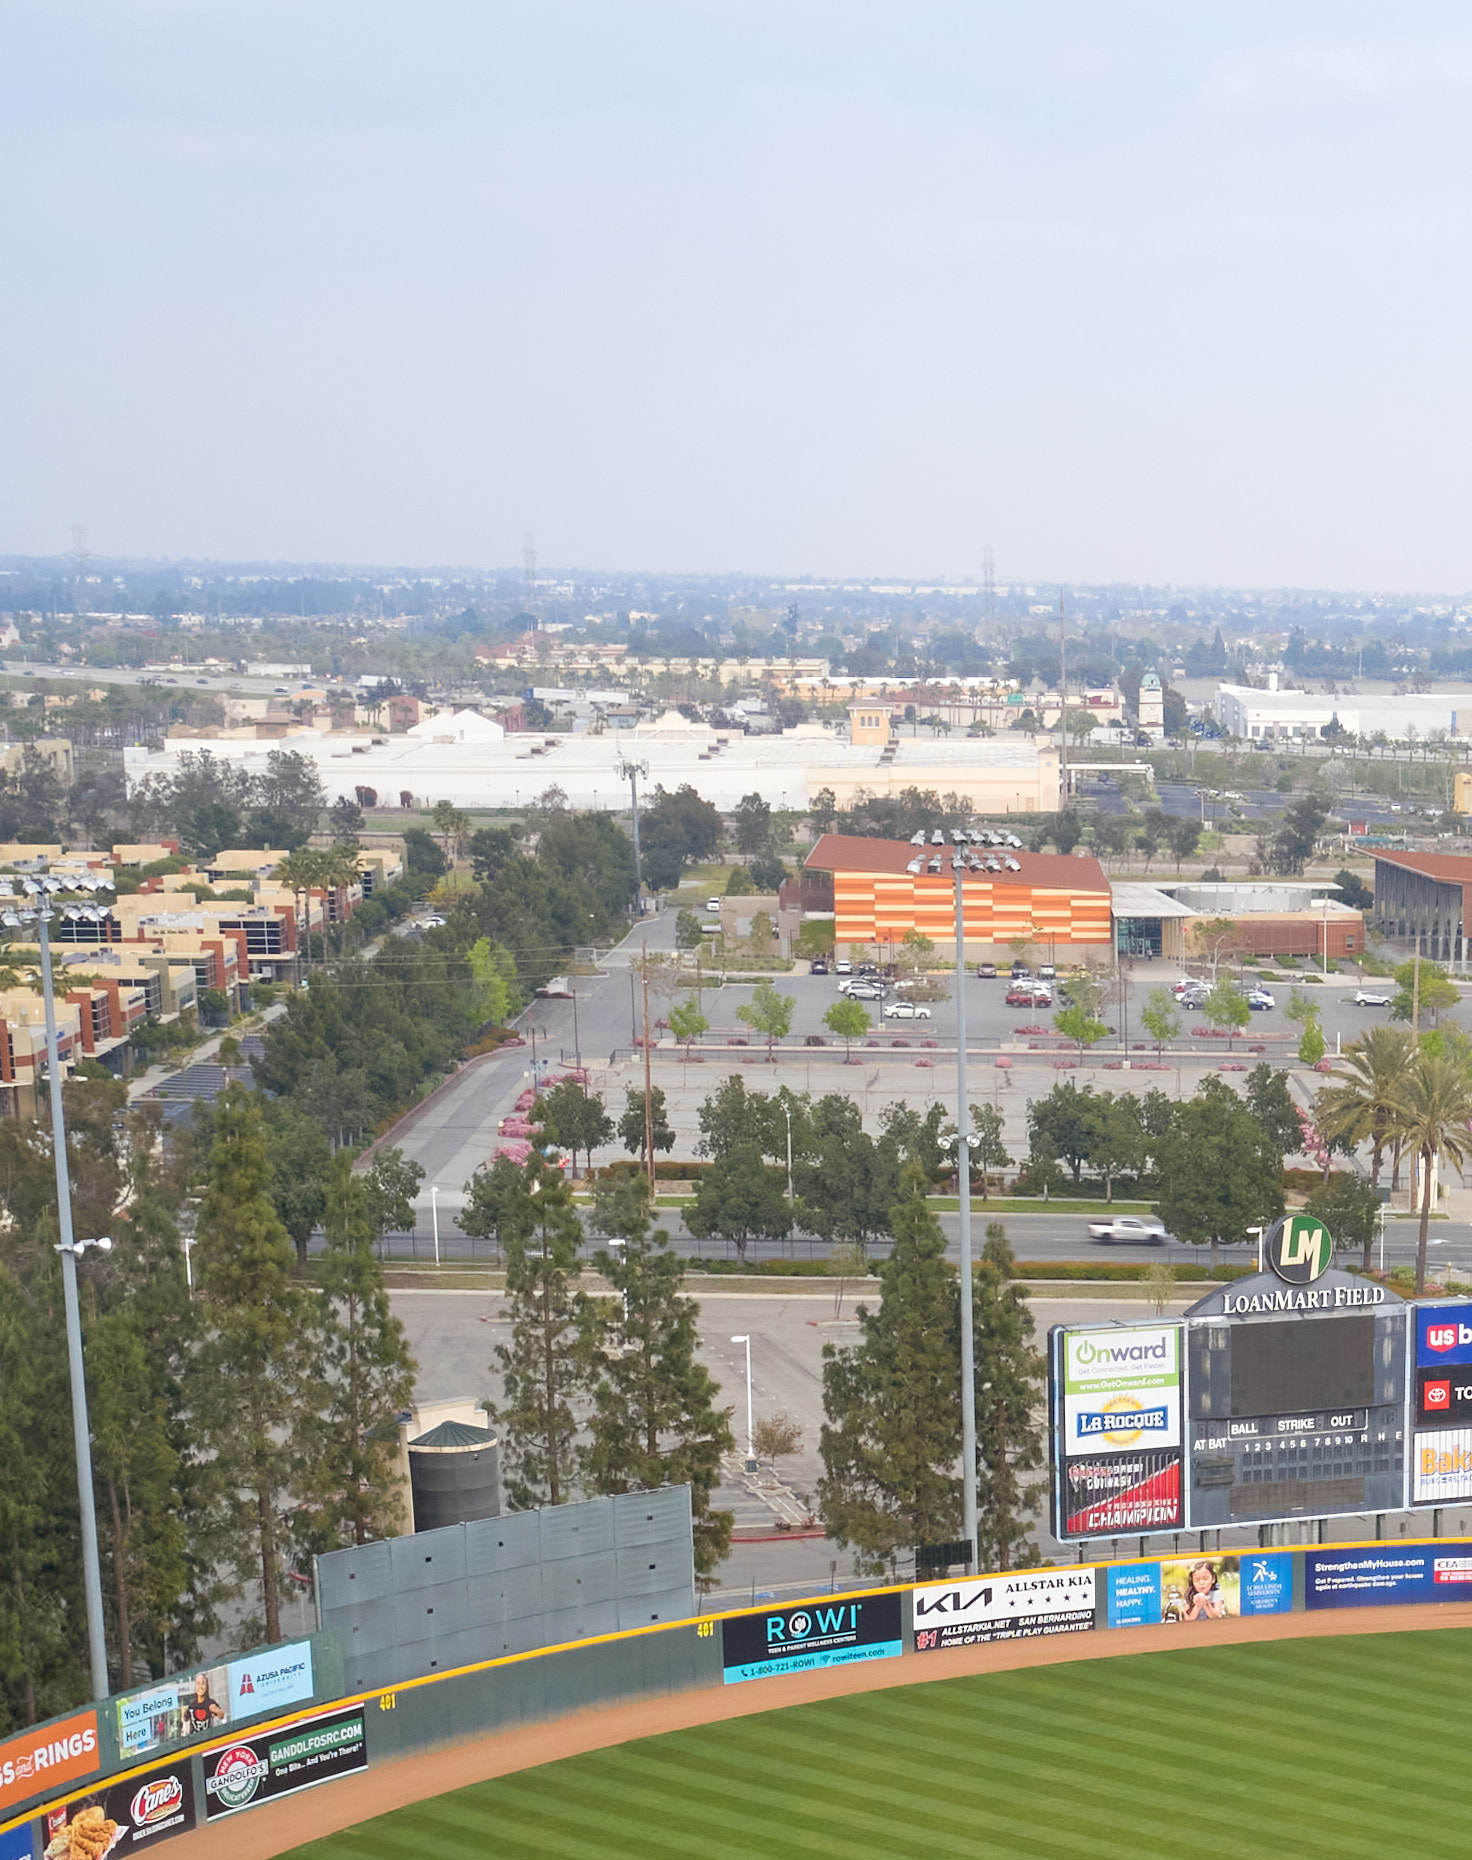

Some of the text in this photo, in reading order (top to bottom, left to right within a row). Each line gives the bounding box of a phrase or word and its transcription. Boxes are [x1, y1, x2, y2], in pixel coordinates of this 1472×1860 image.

[1429, 1329, 1455, 1346] us
[1076, 1337, 1166, 1364] Onward
[1079, 1376, 1165, 1391] www.GetOnward.com
[1231, 1415, 1353, 1435] BALL STRIKE OUT
[1194, 1438, 1227, 1450] AT BAT
[1344, 1436, 1353, 1444] 10
[1361, 1434, 1368, 1442] R
[1378, 1432, 1385, 1441] H
[1315, 1558, 1424, 1572] StrengthenMyHouse.com
[1006, 1576, 1092, 1594] ALLSTAR KIA
[1116, 1586, 1156, 1596] HEALTHY.
[767, 1604, 856, 1642] ROWI
[942, 1611, 1092, 1636] ALLSTARKIA.NET SAN BERNARDINO
[916, 1629, 937, 1649] #1
[941, 1637, 963, 1647] HOME
[964, 1636, 975, 1644] OF
[976, 1634, 991, 1642] THE
[1022, 1628, 1042, 1637] PLAY
[832, 1649, 885, 1663] rowiteen.com
[256, 1670, 279, 1684] AZUSA
[124, 1696, 173, 1718] You Belong
[126, 1727, 146, 1742] Here
[270, 1723, 362, 1763] GANDOLFOSRC.COM
[34, 1729, 96, 1771] RINGS
[210, 1763, 265, 1790] GANDOLFO'S
[132, 1776, 182, 1817] Cane's
